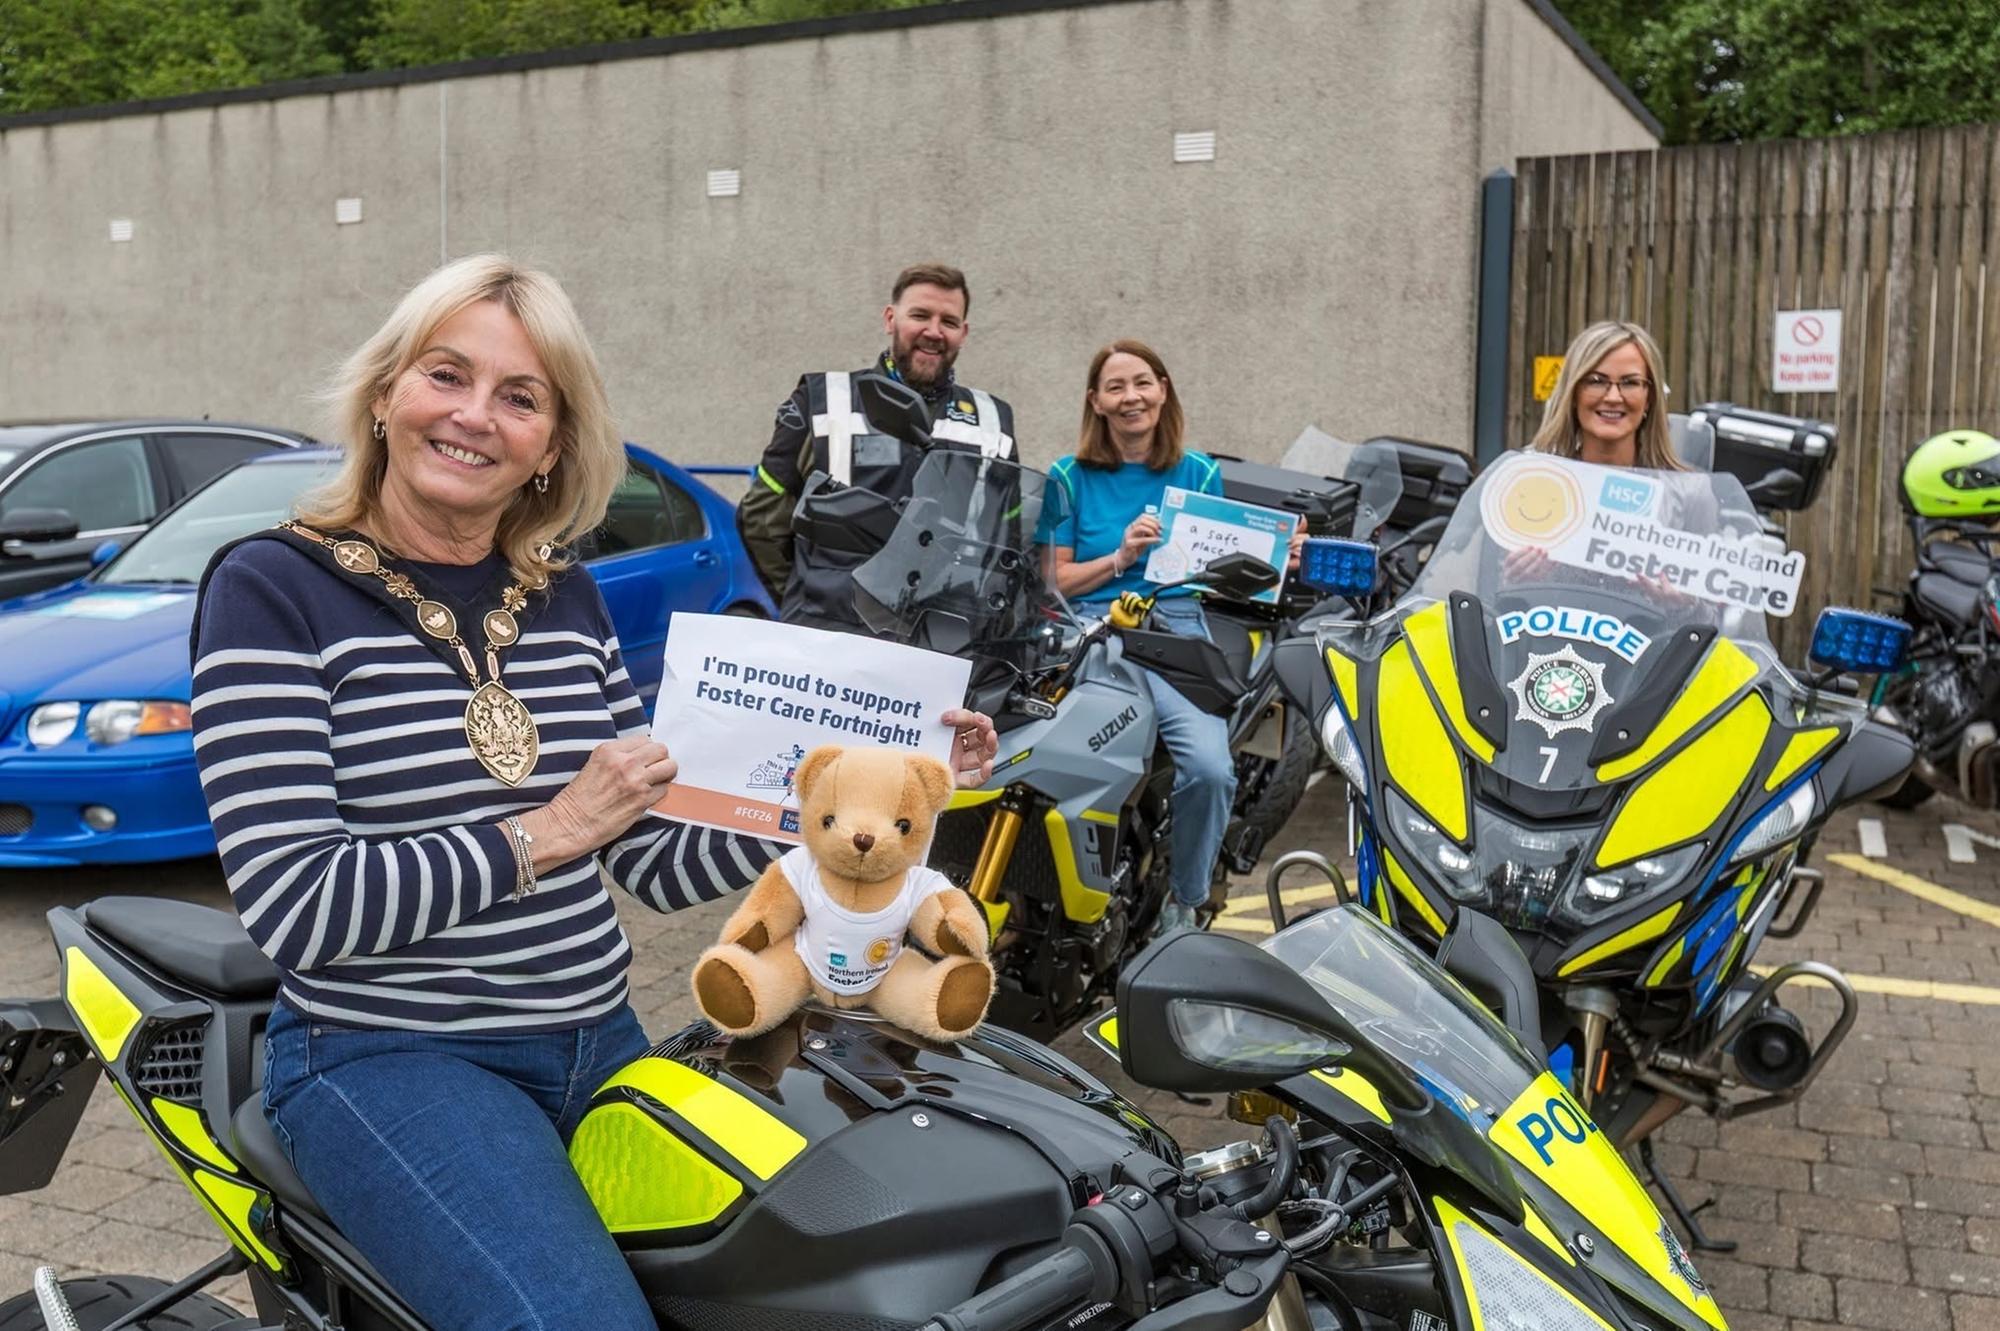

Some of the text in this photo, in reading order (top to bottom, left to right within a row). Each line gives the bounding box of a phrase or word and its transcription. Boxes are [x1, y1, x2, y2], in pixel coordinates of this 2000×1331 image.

[1796, 353, 1835, 365] parking
[1607, 485, 1643, 505] HSC
[1190, 525, 1239, 546] a safe
[1191, 541, 1225, 557] place
[1592, 511, 1799, 578] Northern Ireland
[1585, 537, 1790, 611] Foster Care
[1502, 610, 1645, 658] POLICE
[703, 656, 922, 719] I'm proud to support
[696, 681, 922, 748] Foster Care Fortnight!
[1088, 705, 1138, 753] SUZUKI
[1539, 746, 1559, 783] 7
[735, 806, 773, 823] #FCF26
[828, 966, 864, 977] Northern
